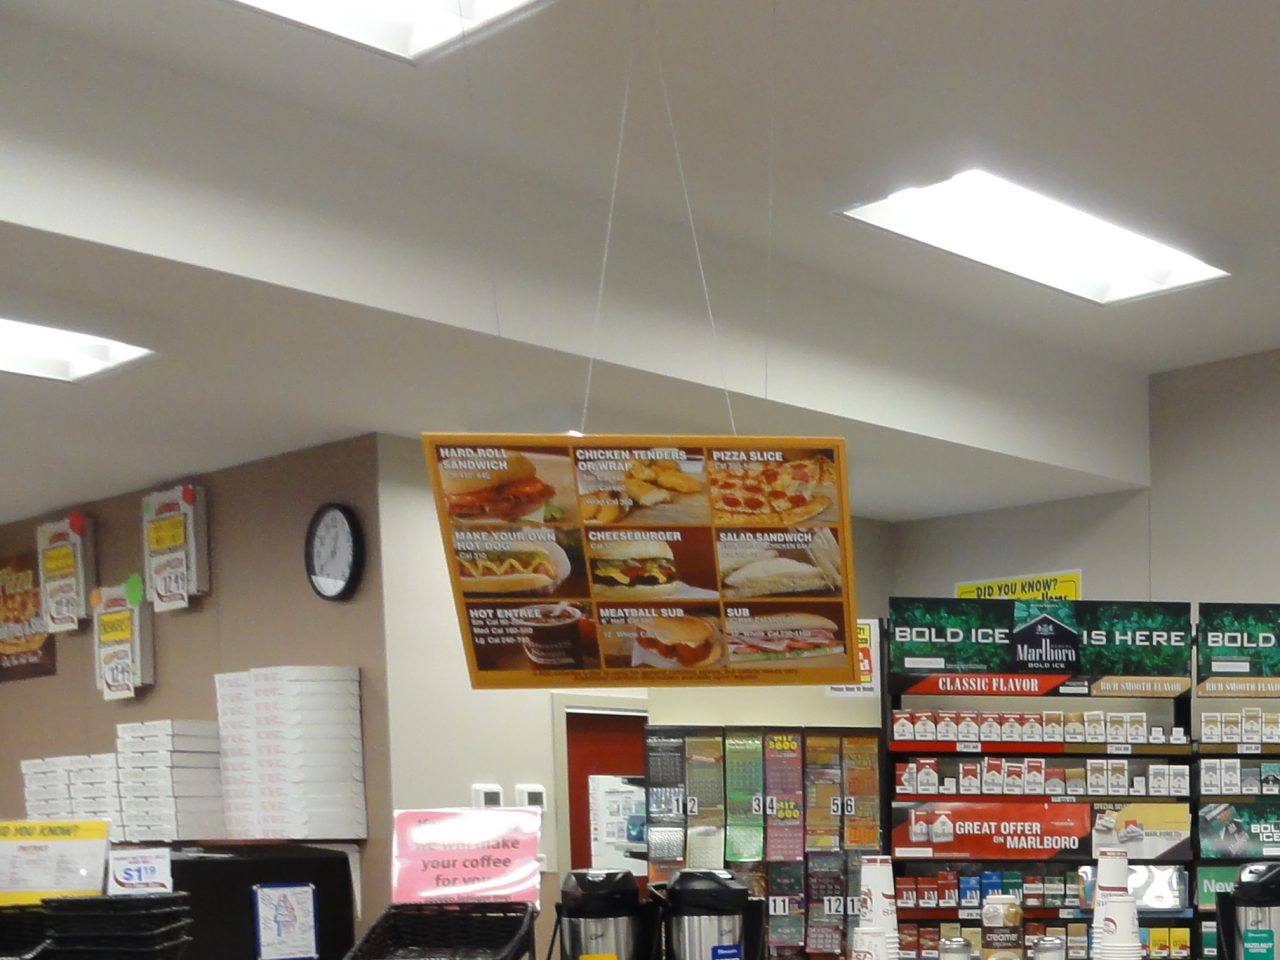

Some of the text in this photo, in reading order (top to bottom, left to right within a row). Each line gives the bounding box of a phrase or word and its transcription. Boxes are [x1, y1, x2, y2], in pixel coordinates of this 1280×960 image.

[440, 448, 508, 459] HARD ROLL
[576, 450, 687, 460] CHICKEN TENDERS
[712, 451, 783, 461] PIZZA SLICE
[443, 461, 508, 470] SANDWICH
[578, 461, 632, 471] OR WRAP
[455, 532, 556, 542] MAKE YOUR OWN
[588, 531, 682, 541] CHEESEBURGER
[720, 532, 812, 542] SALAD SANDWICH
[457, 541, 511, 551] HOT DOG
[976, 578, 1058, 598] DID YOU KNOW?
[469, 608, 543, 619] HOT ENTREE
[600, 608, 684, 618] MEATBALL SUB
[727, 608, 750, 617] SUB
[895, 627, 1010, 644] BOLD ICE
[1083, 630, 1185, 646] IS HERE
[1208, 633, 1275, 647] BOLD
[1016, 639, 1076, 661] Marlboro
[938, 676, 1039, 692] CLASSIC FLAVOR
[1101, 682, 1181, 691] RICH SMOOTH FLAVOR
[1206, 682, 1223, 691] RICH
[1225, 682, 1255, 691] SMOOTH
[676, 799, 681, 813] 1
[689, 799, 697, 813] 2
[754, 798, 761, 812] 3
[767, 798, 775, 812] 4
[832, 798, 840, 813] 5
[845, 798, 853, 813] 6
[956, 822, 1040, 835] GREAT OFFER
[1007, 836, 1079, 849] MARLBORO
[421, 855, 512, 872] your coffee
[435, 875, 457, 887] for
[771, 899, 786, 913] 11
[827, 898, 843, 913] 12
[986, 932, 1018, 943] creamer
